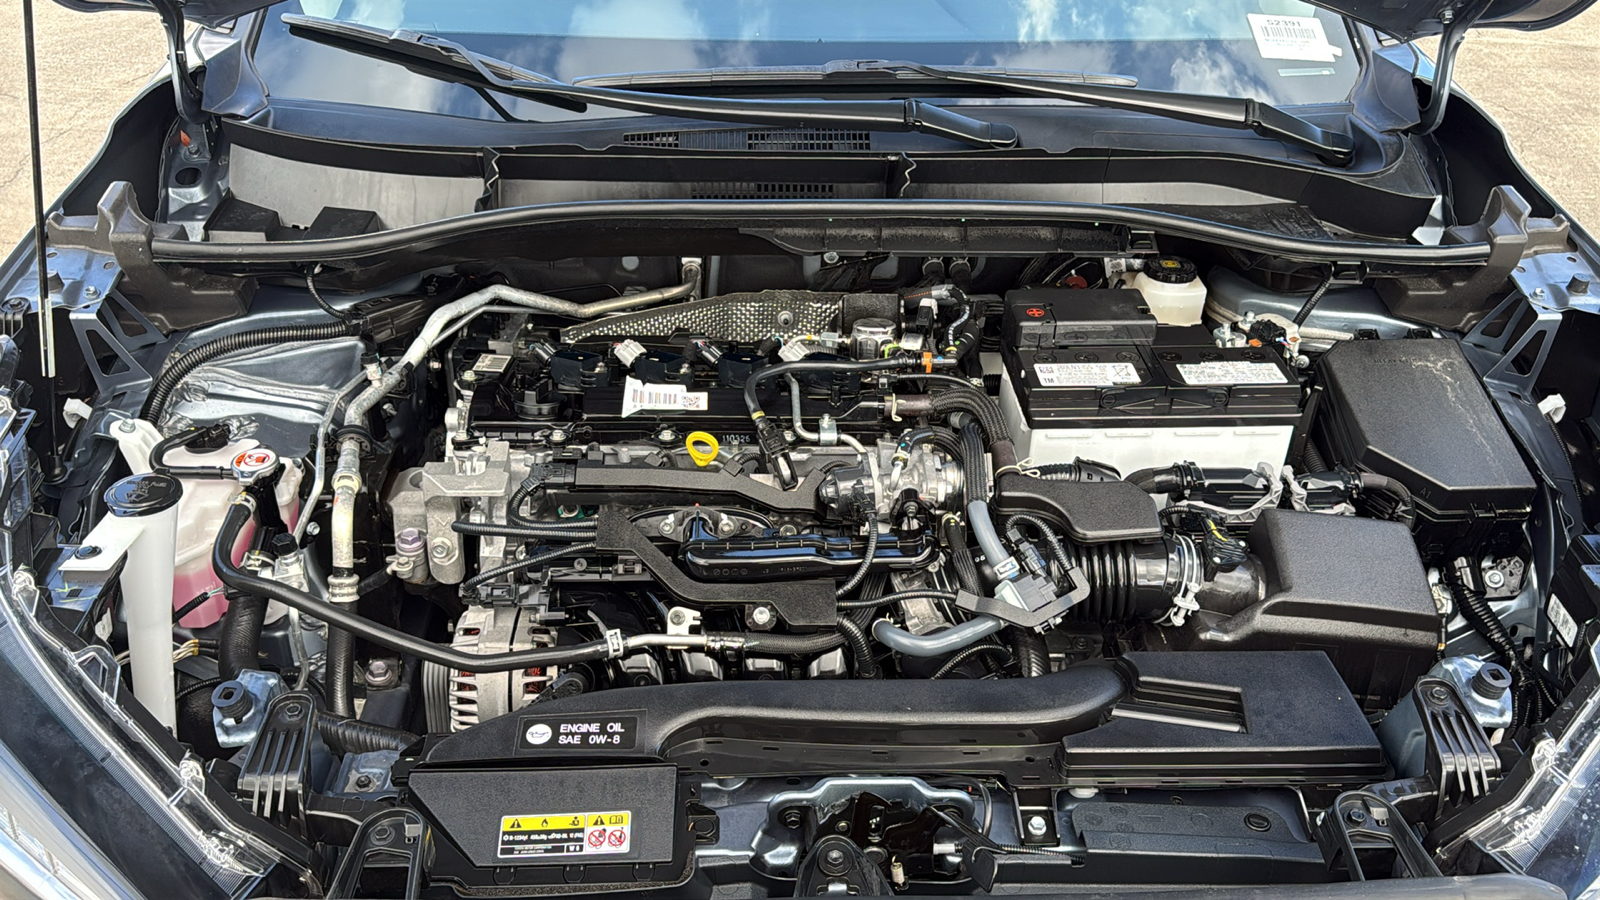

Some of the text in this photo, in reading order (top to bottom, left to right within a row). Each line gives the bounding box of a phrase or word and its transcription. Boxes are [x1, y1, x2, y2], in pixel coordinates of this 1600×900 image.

[1266, 19, 1301, 27] 52391
[559, 722, 625, 733] ENGINE OIL
[558, 734, 620, 744] SAE 0W-8
